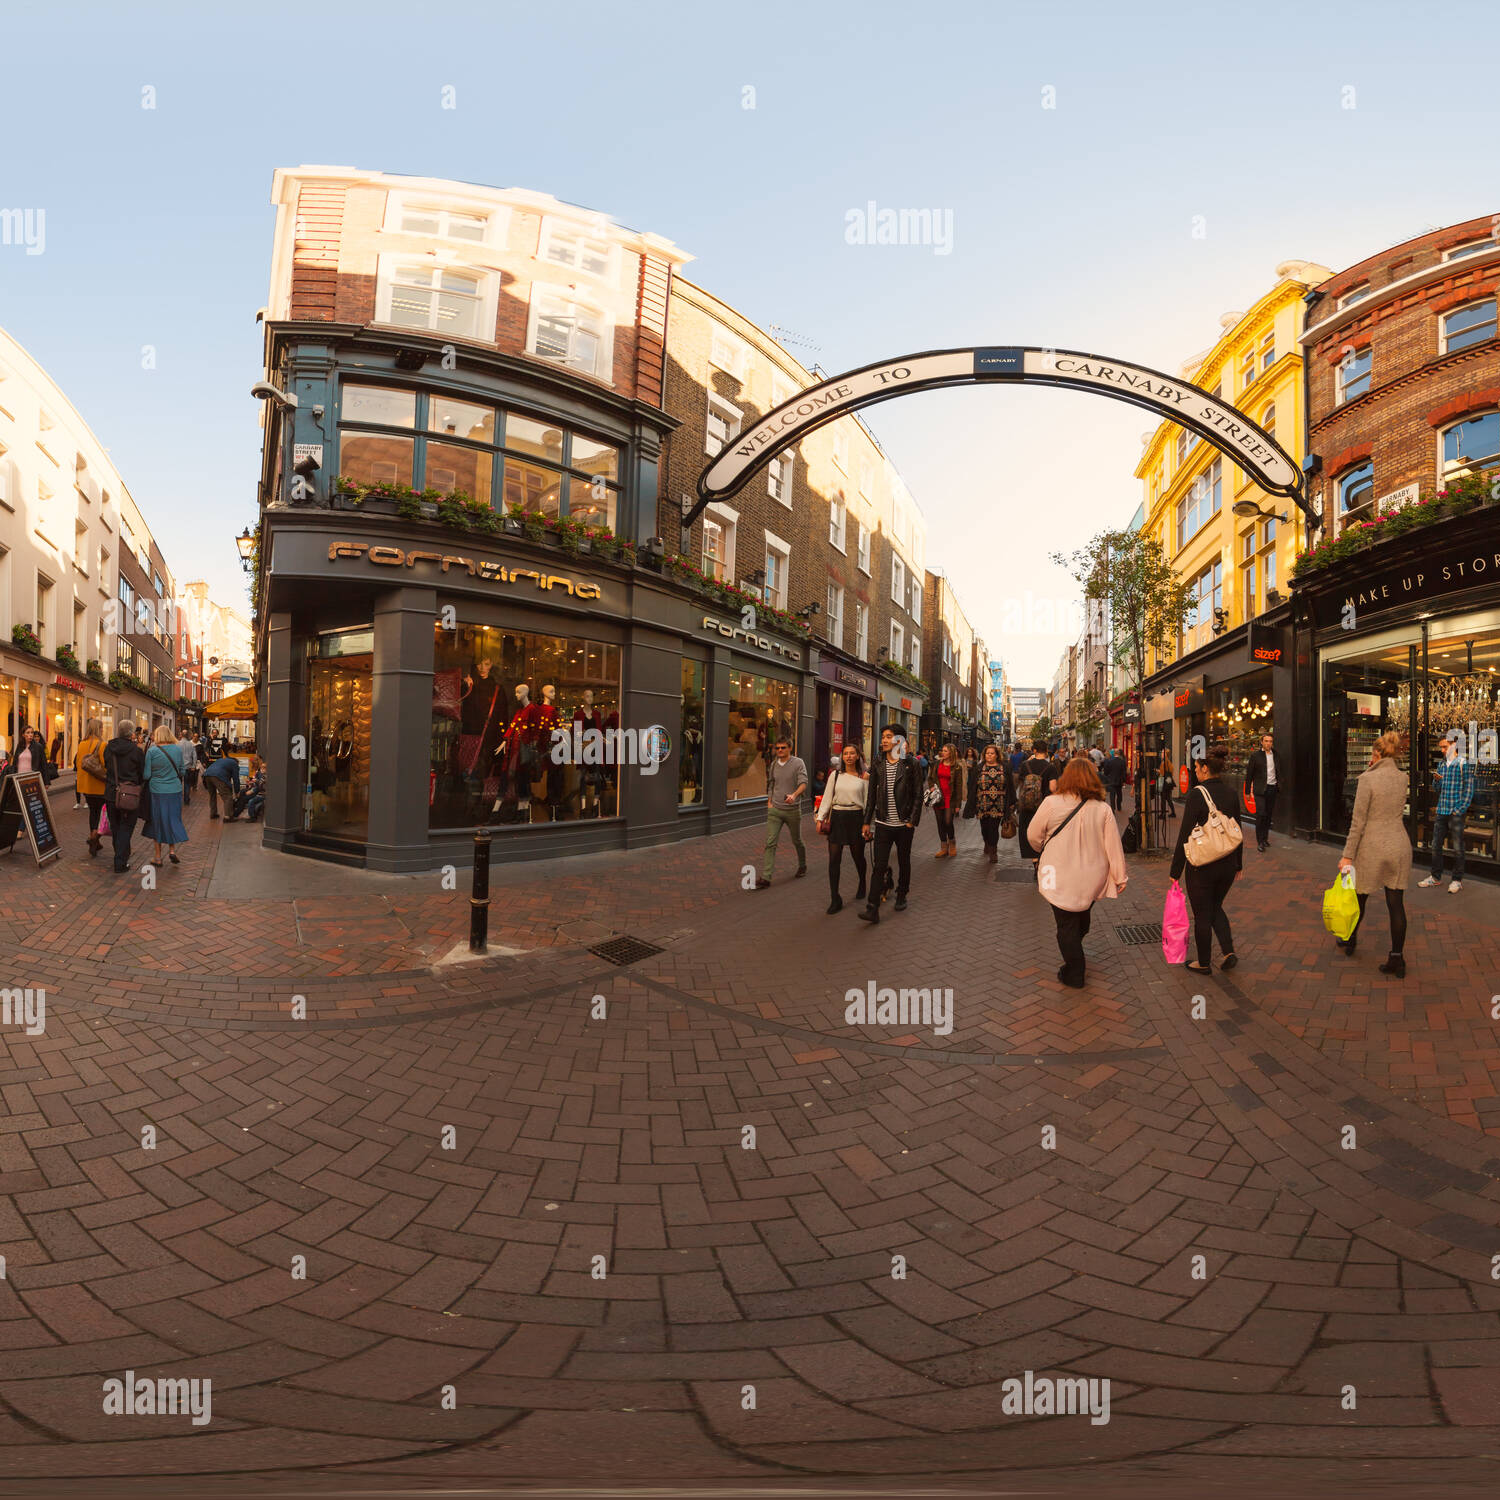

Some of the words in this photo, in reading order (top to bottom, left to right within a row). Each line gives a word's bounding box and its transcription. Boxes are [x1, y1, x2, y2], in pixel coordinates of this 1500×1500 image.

[735, 384, 853, 458] WELCOME
[873, 366, 912, 384] TO
[1055, 359, 1193, 405] CARNABY
[1200, 407, 1279, 468] STREET
[1381, 488, 1410, 506] CARNABY
[1345, 585, 1390, 609] MAKE
[1403, 574, 1425, 591] UP
[1254, 647, 1281, 661] size?
